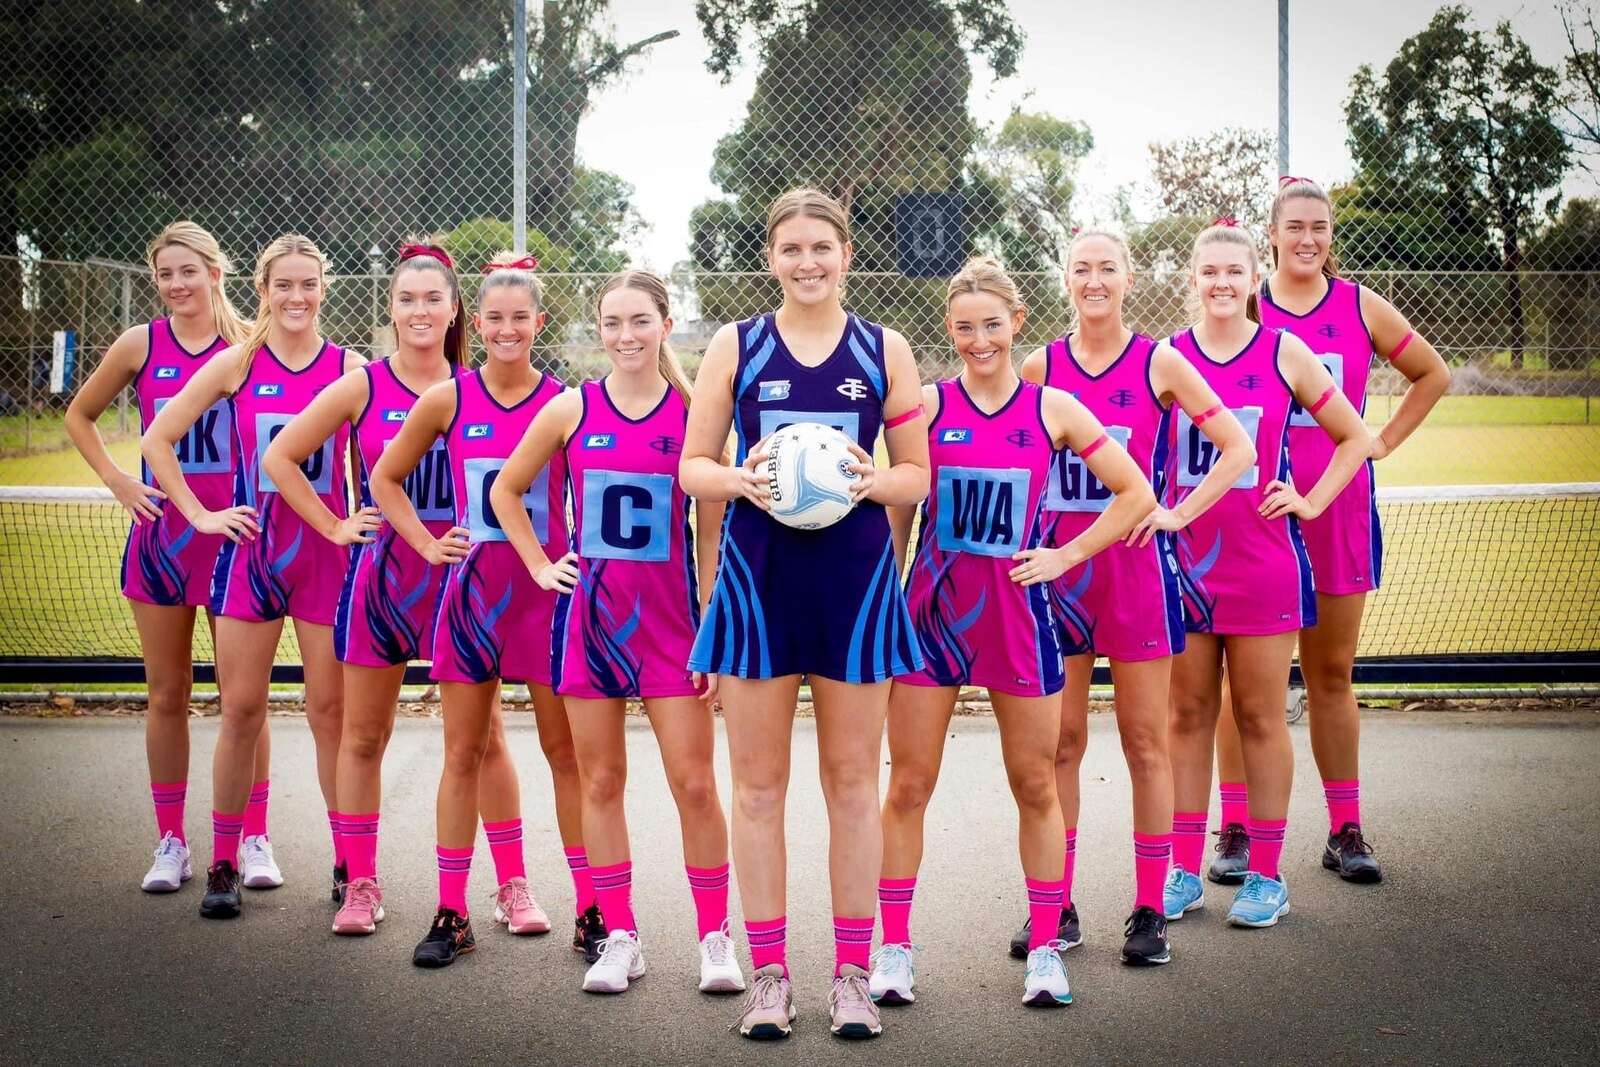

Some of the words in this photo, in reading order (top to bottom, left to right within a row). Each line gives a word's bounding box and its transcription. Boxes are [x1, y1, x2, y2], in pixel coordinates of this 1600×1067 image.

[1188, 422, 1222, 476] G
[601, 484, 653, 550] C
[952, 478, 1014, 545] WA
